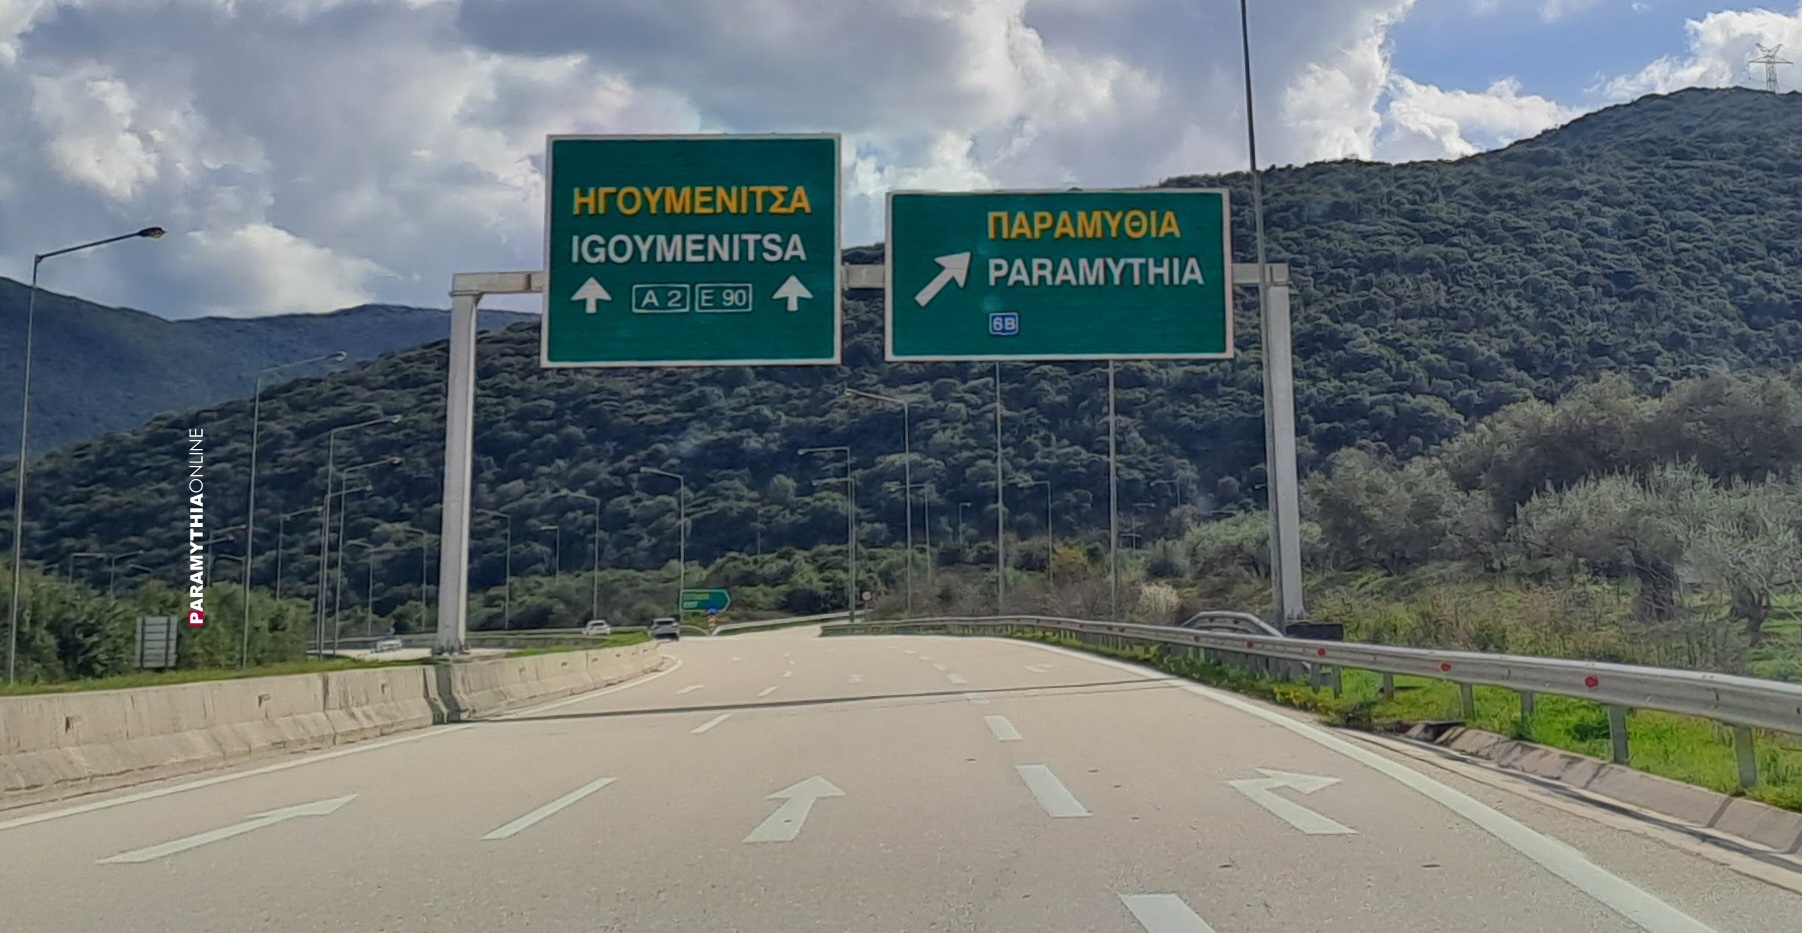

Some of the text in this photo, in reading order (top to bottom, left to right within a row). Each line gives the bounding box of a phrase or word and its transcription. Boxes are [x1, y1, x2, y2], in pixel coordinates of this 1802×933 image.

[572, 186, 811, 215] ΗΓΟΥΜΕΝΙΤΣΑ
[987, 210, 1181, 239] ΠΑΡΑΜΥΘΙΑ
[571, 234, 807, 263] IGOYMENITSA
[988, 257, 1205, 286] PARAMYTHIA
[641, 290, 682, 307] A 2
[701, 289, 747, 306] E 90
[993, 317, 1016, 331] 6B
